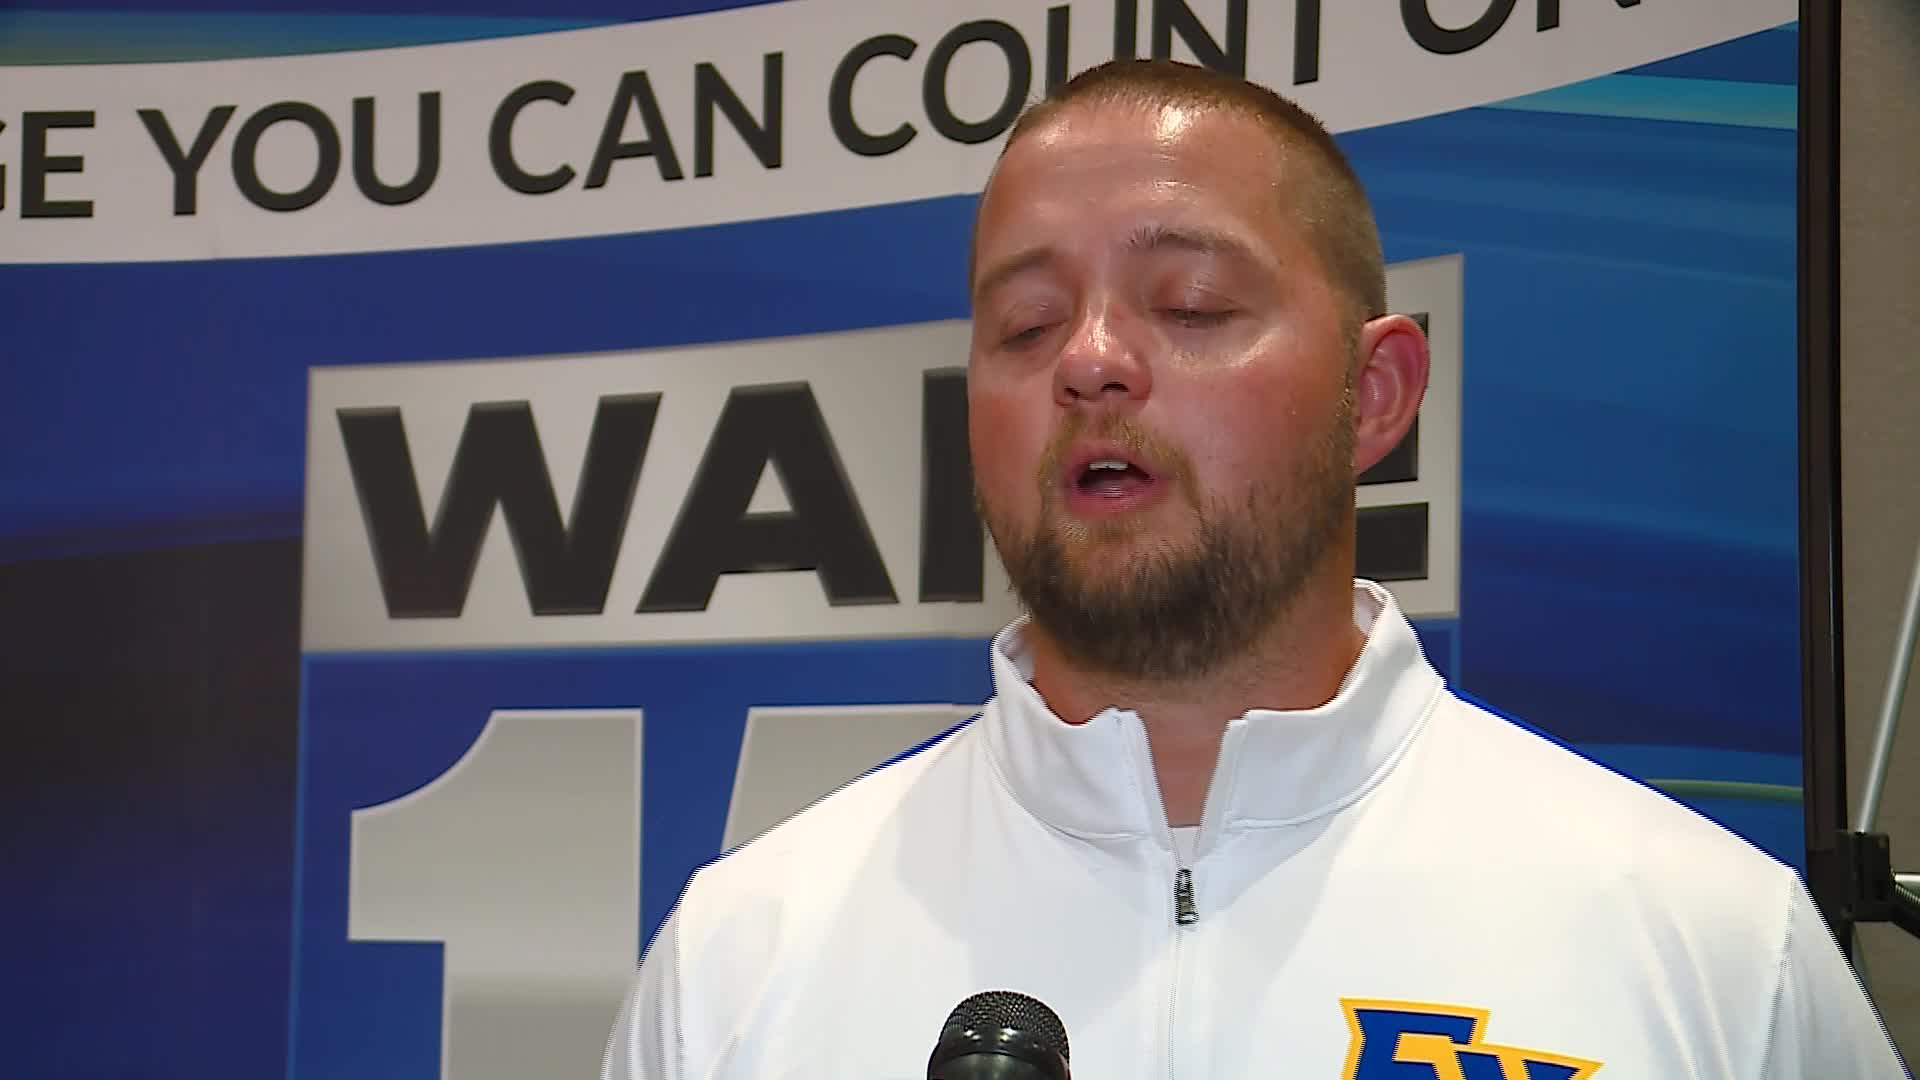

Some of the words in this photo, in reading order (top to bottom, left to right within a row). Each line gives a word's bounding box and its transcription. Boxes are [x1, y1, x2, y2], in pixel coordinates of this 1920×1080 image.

[0, 110, 96, 219] E
[136, 91, 442, 215] YOU
[488, 51, 784, 195] CAN
